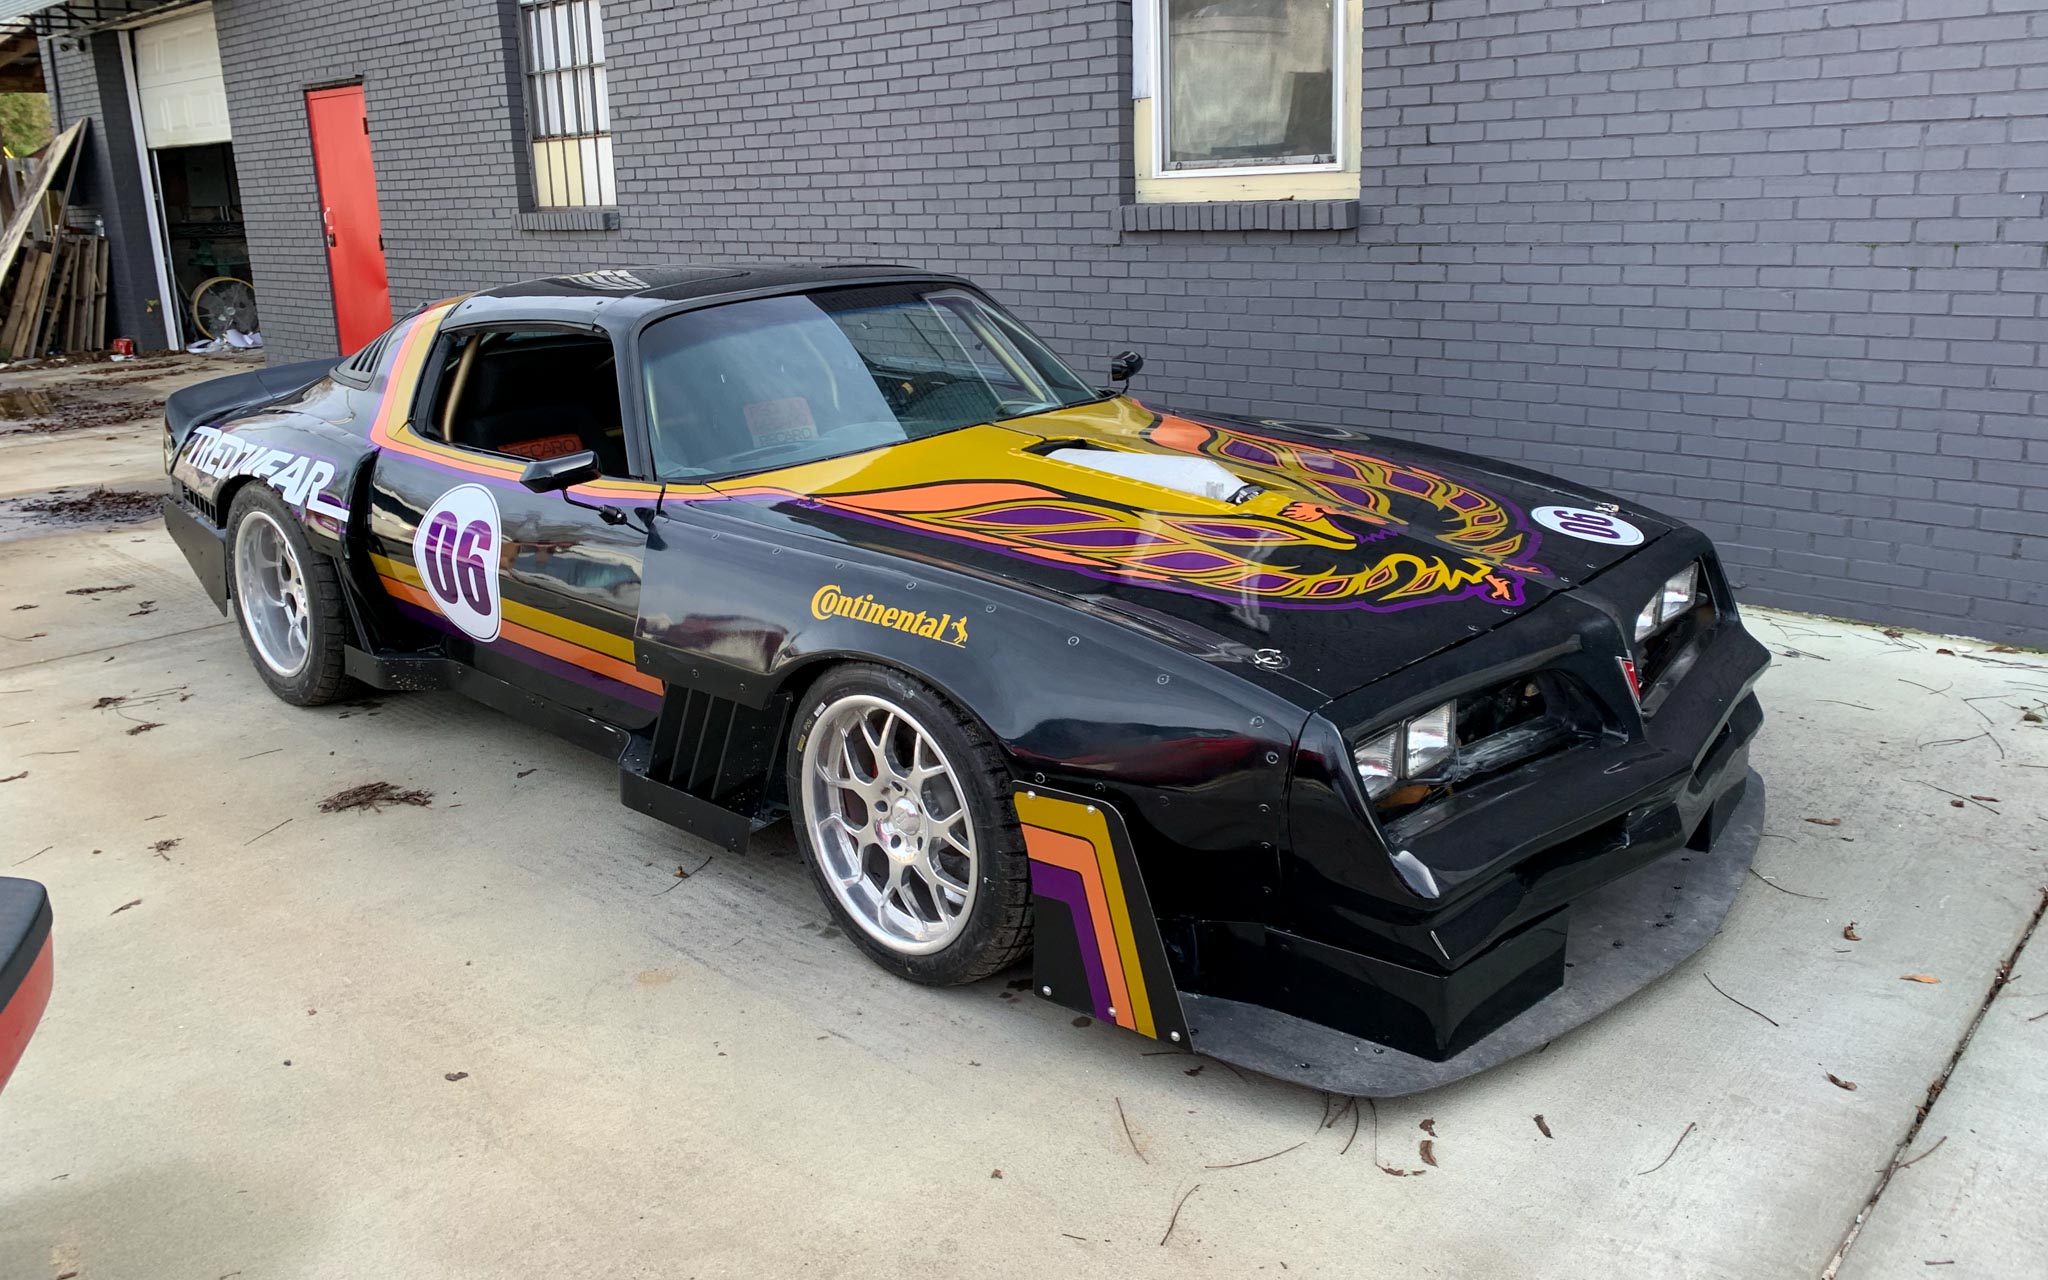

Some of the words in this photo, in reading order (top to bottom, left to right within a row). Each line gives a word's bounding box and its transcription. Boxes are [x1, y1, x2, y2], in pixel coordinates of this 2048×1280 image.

[185, 426, 350, 522] TREDWEAR
[1553, 510, 1621, 539] 06
[424, 510, 492, 616] 06
[811, 584, 951, 641] Continental
